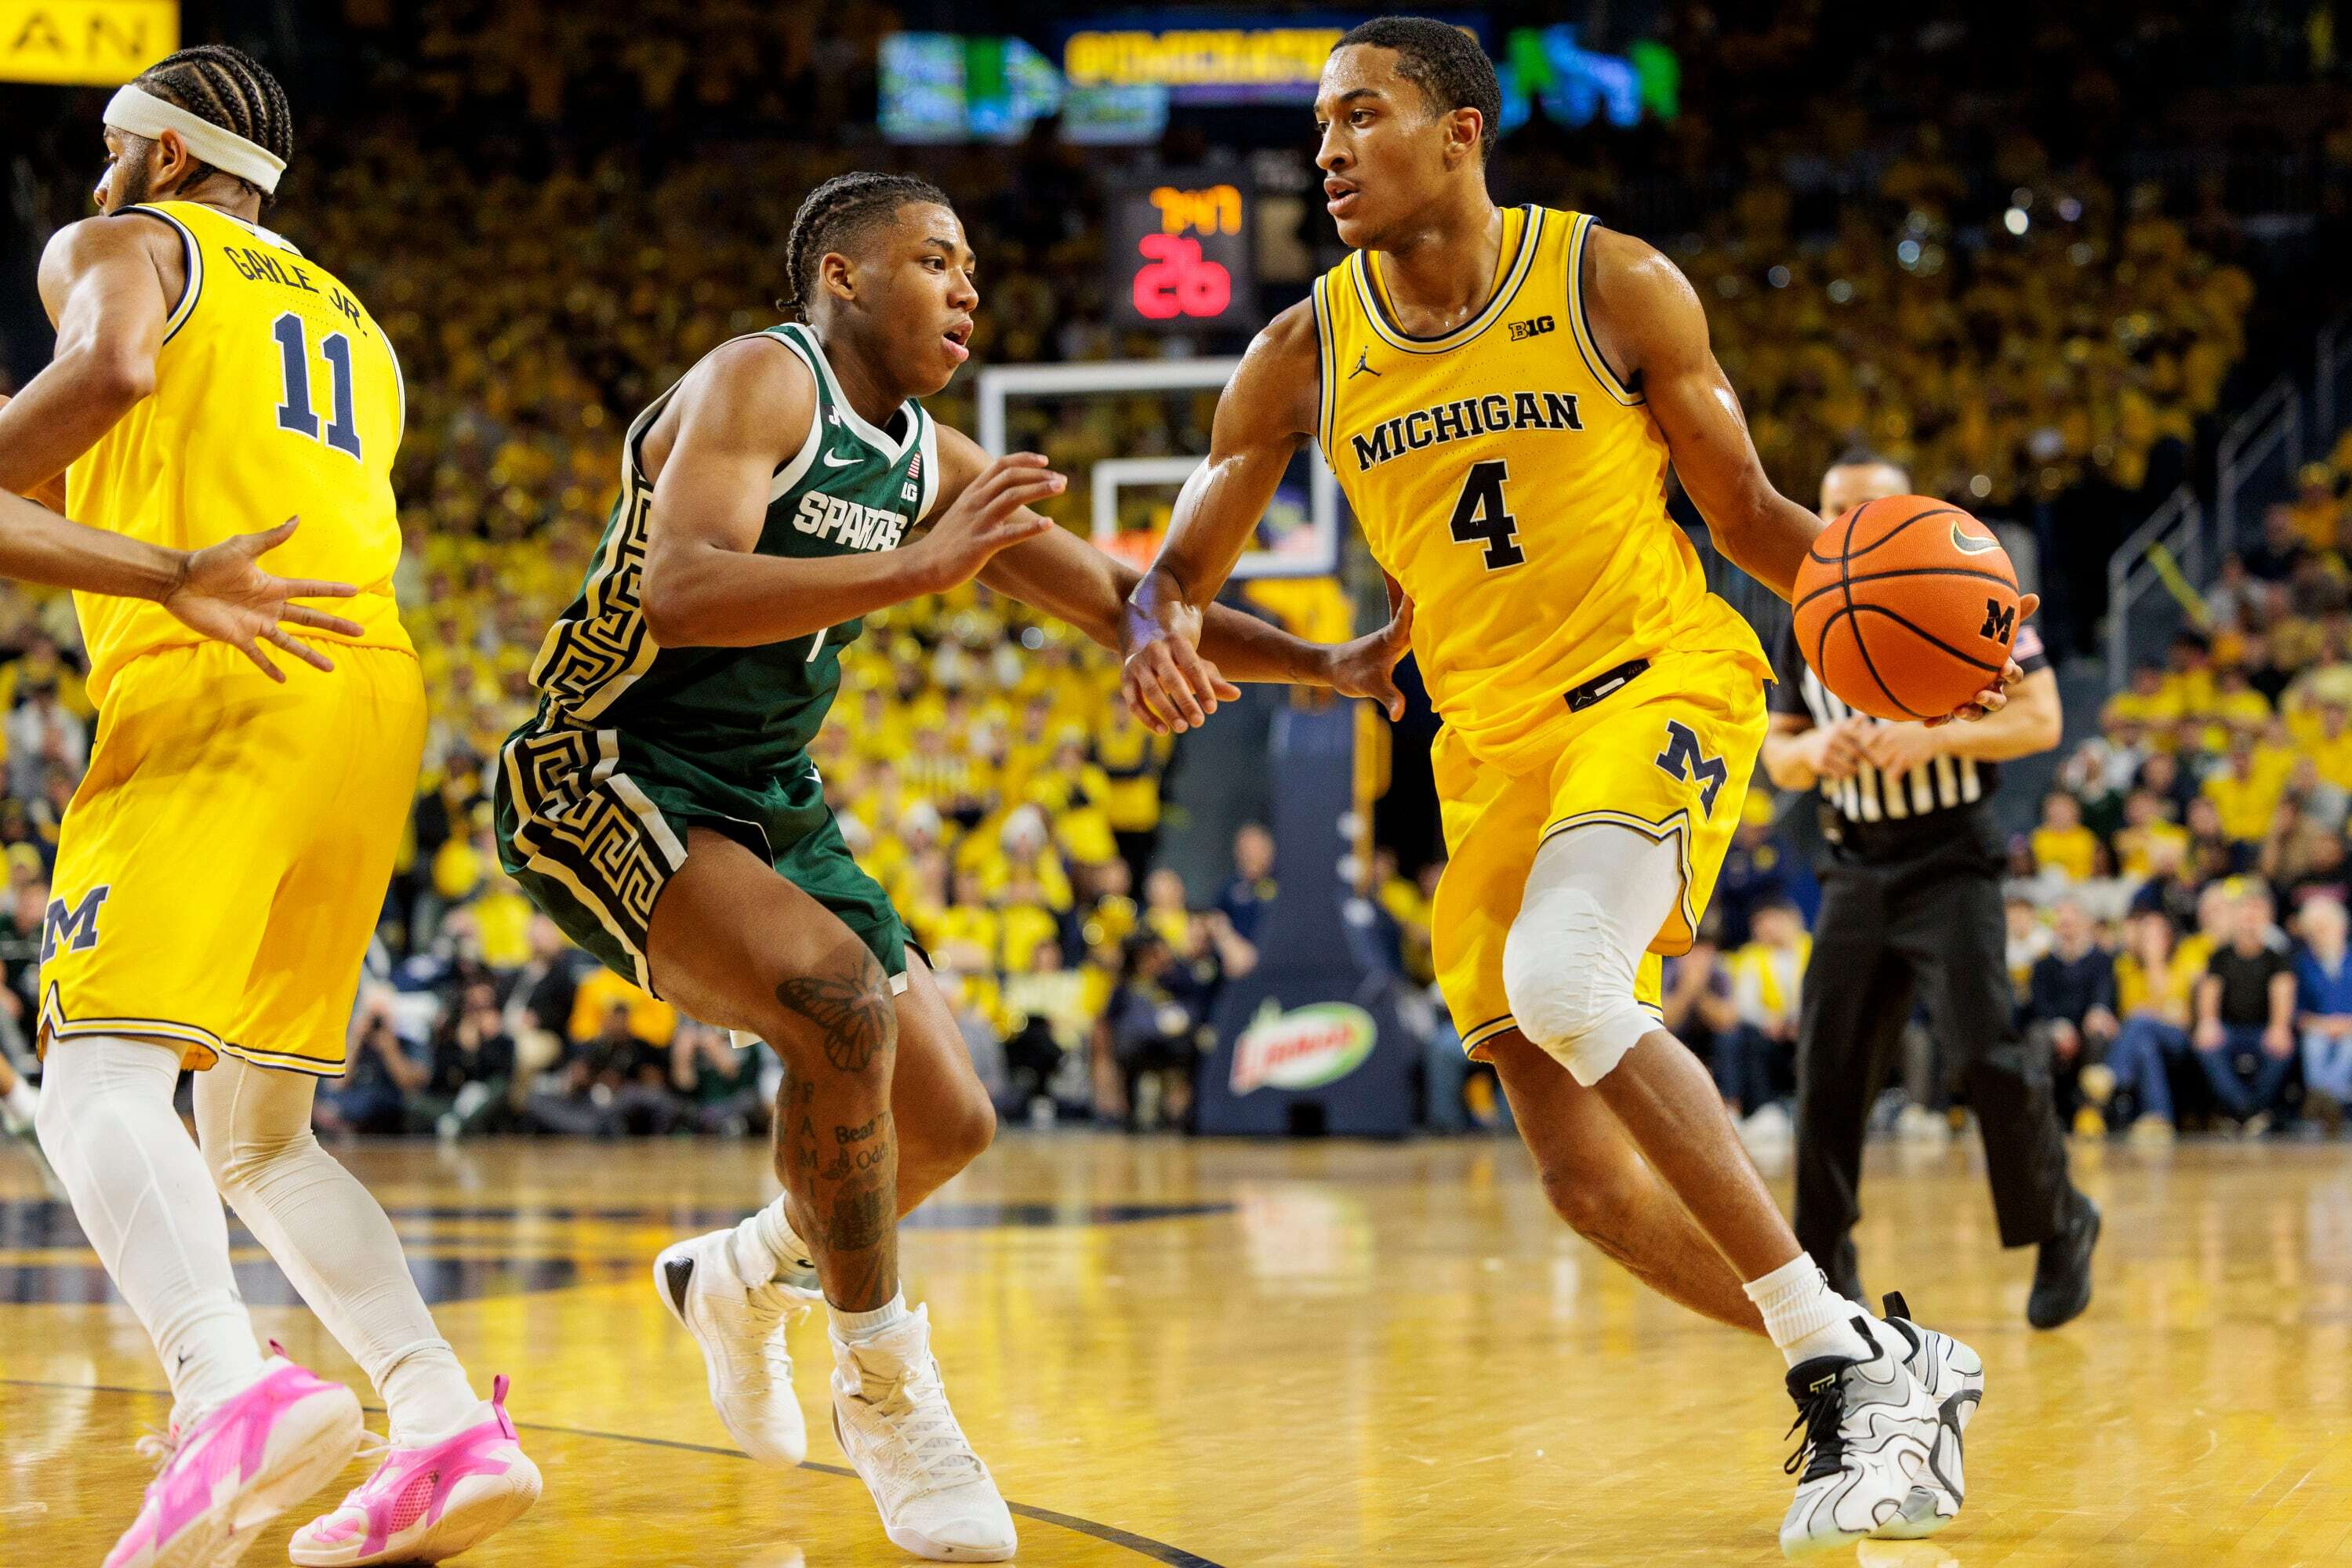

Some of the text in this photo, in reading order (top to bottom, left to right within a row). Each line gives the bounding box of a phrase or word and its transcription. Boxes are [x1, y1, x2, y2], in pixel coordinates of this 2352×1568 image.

[223, 246, 368, 337] GAYLE JR.
[271, 310, 364, 464] 11
[1350, 391, 1585, 474] MICHIGAN
[1448, 457, 1528, 573] 4
[1979, 597, 2016, 646] M
[1653, 717, 1730, 823] M
[39, 884, 112, 967] M
